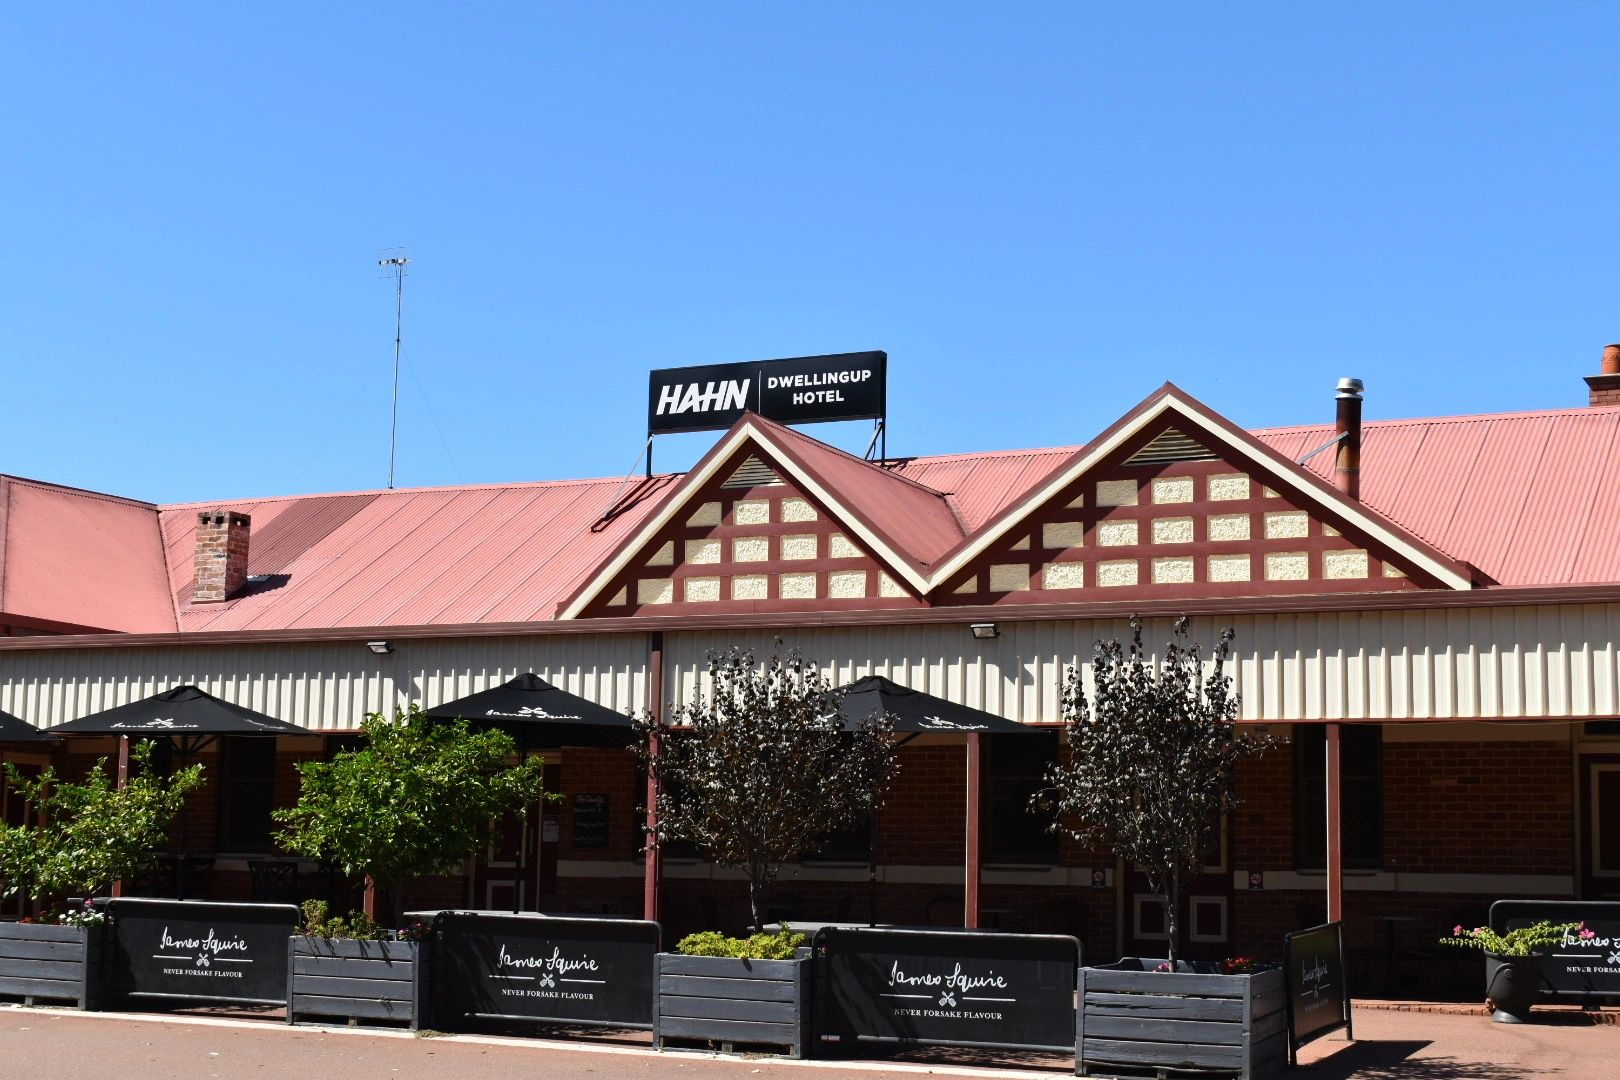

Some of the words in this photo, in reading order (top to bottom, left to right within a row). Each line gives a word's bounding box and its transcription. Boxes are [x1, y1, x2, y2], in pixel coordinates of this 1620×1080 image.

[767, 369, 872, 389] DWELLINGUP
[656, 378, 751, 416] HAHN
[793, 389, 845, 405] HOTEL
[160, 926, 200, 949] James
[202, 928, 248, 955] Squire
[497, 943, 543, 969] James
[545, 946, 599, 975] Squire
[214, 970, 243, 978] FLAVOUR
[889, 960, 942, 987] James
[945, 962, 1008, 993] Squire
[502, 988, 525, 996] NEVER
[527, 990, 559, 998] FORSAKE
[561, 992, 594, 1000] FLAVOUR
[894, 1008, 921, 1016] NEVER
[923, 1010, 961, 1018] FORSAKE
[964, 1011, 1003, 1020] FLAVOUR
